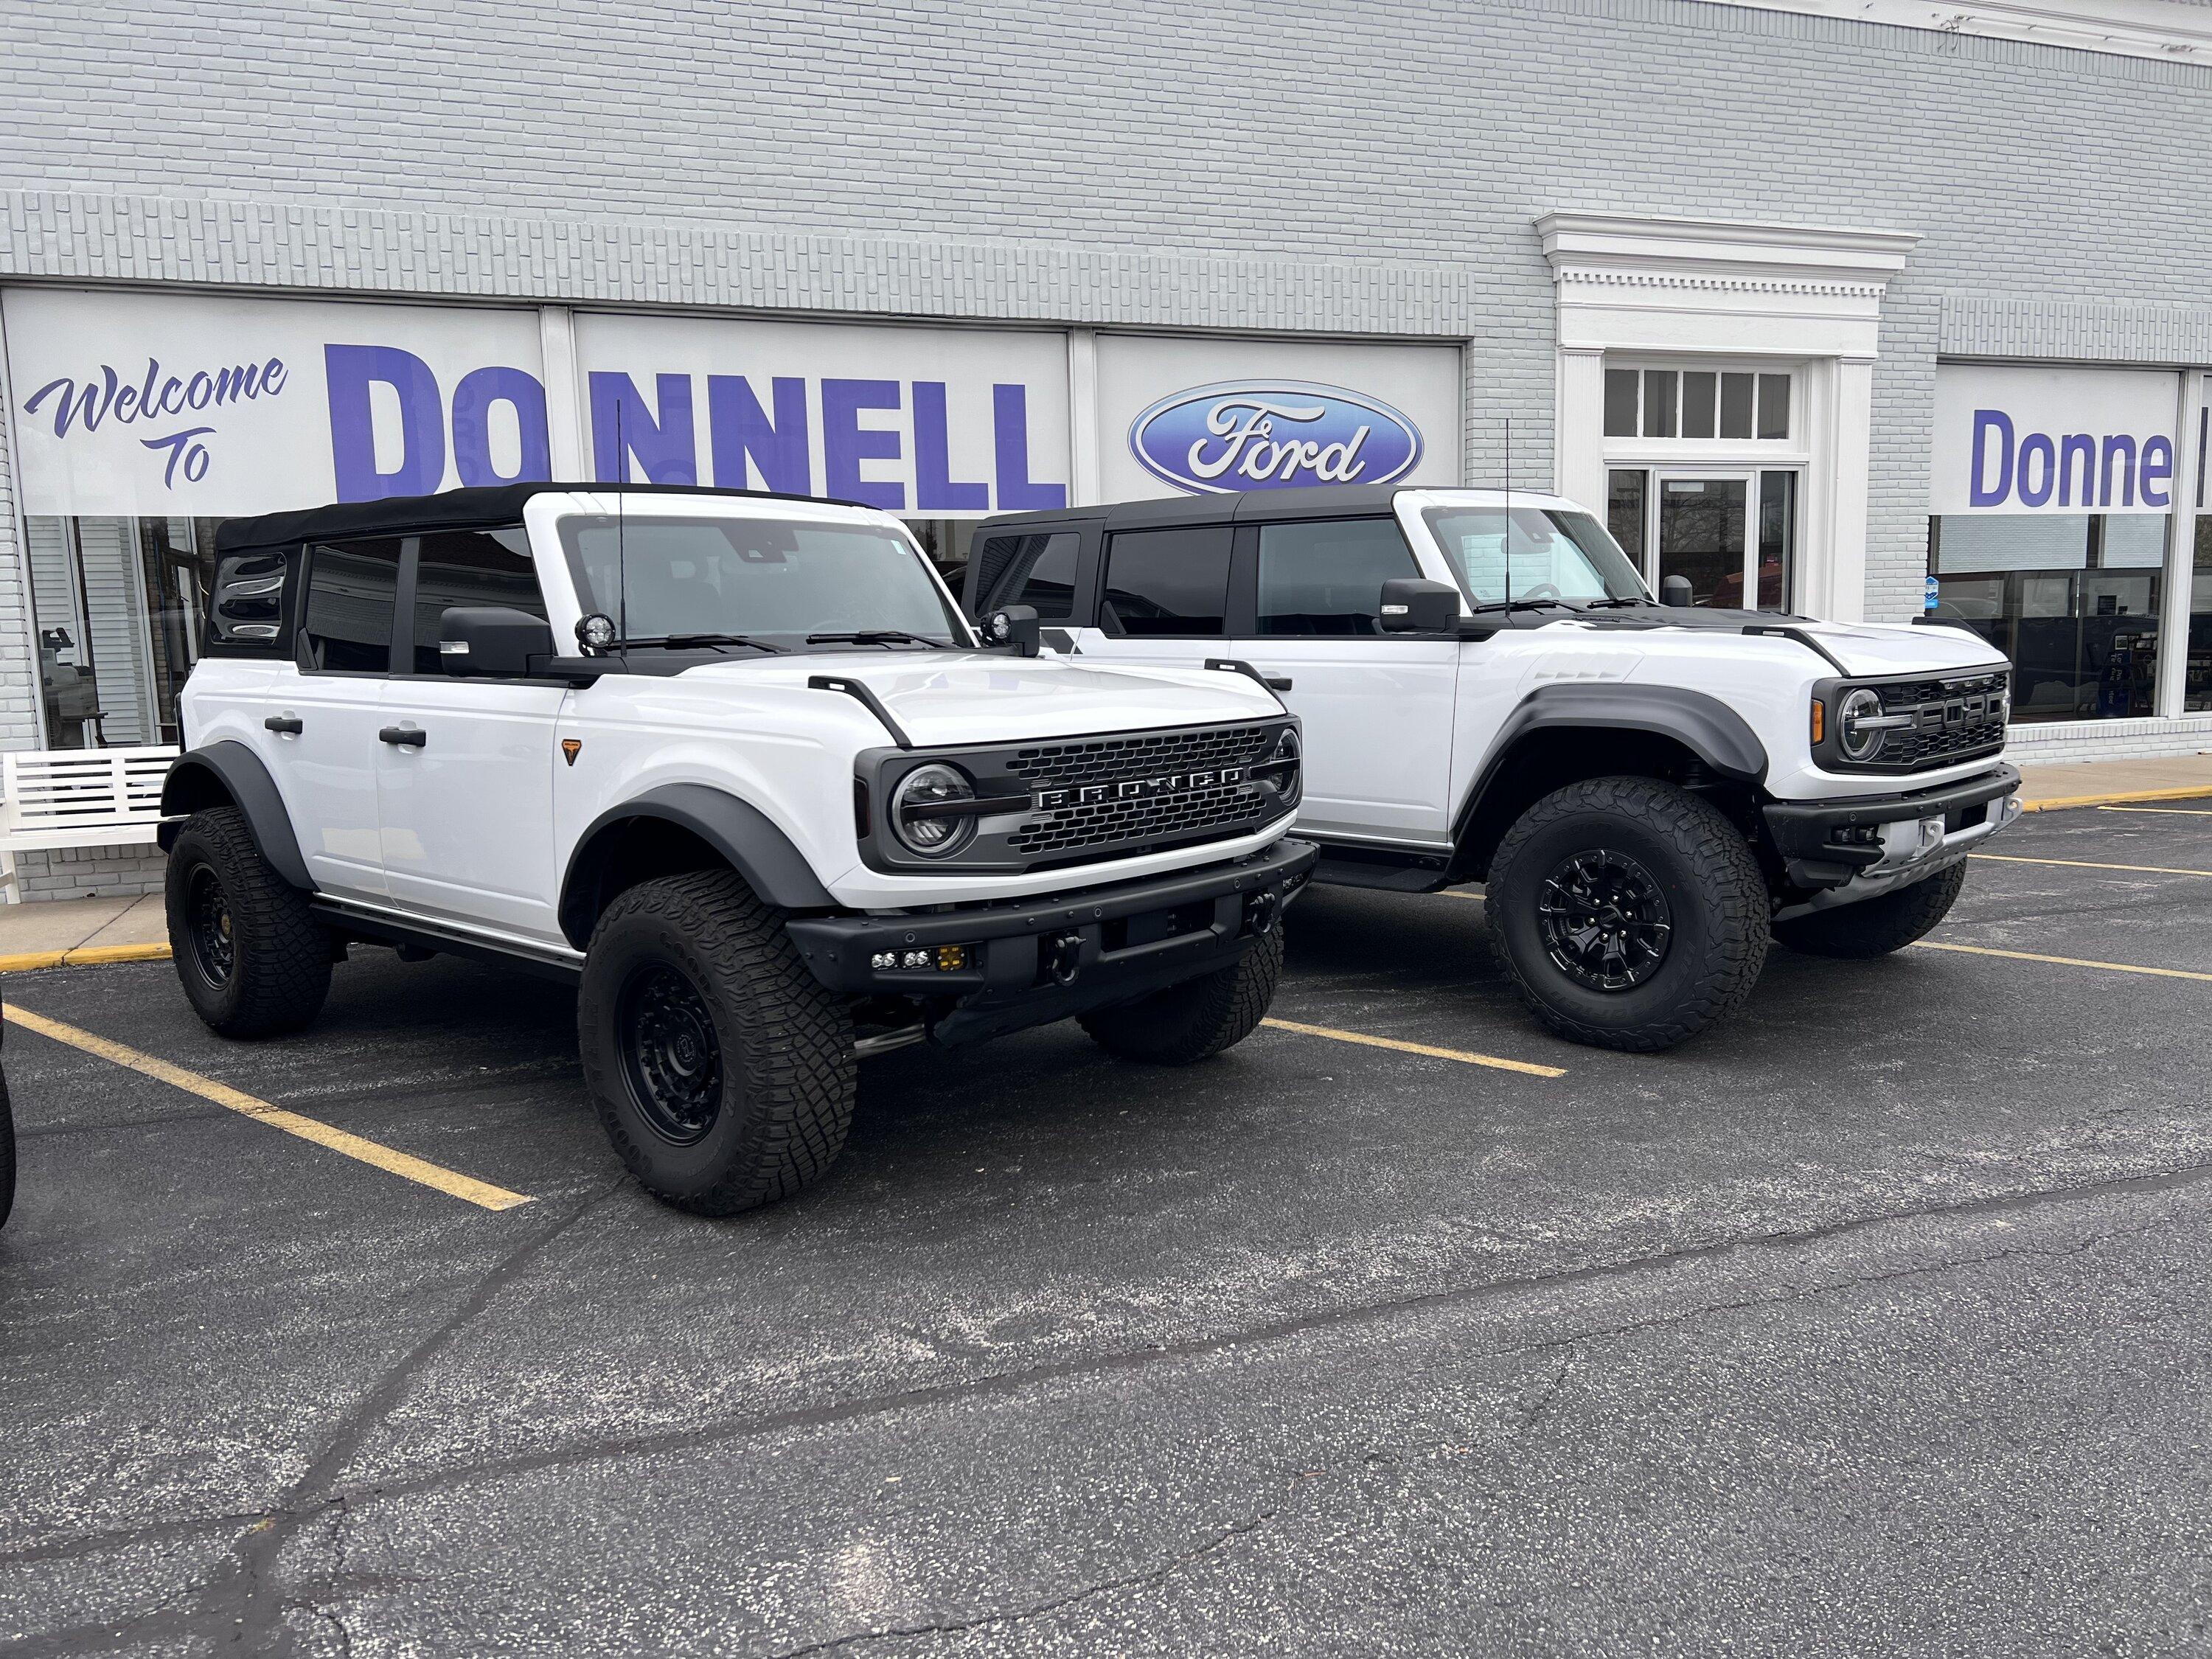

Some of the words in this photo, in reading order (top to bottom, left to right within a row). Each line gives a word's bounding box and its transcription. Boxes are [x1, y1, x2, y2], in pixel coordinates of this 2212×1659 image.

[24, 357, 288, 438] Welcome
[324, 343, 1066, 511] DONNELL
[139, 427, 217, 490] To
[1188, 398, 1371, 482] Ford
[1916, 691, 2006, 734] FORD
[1038, 767, 1244, 809] BRONCO
